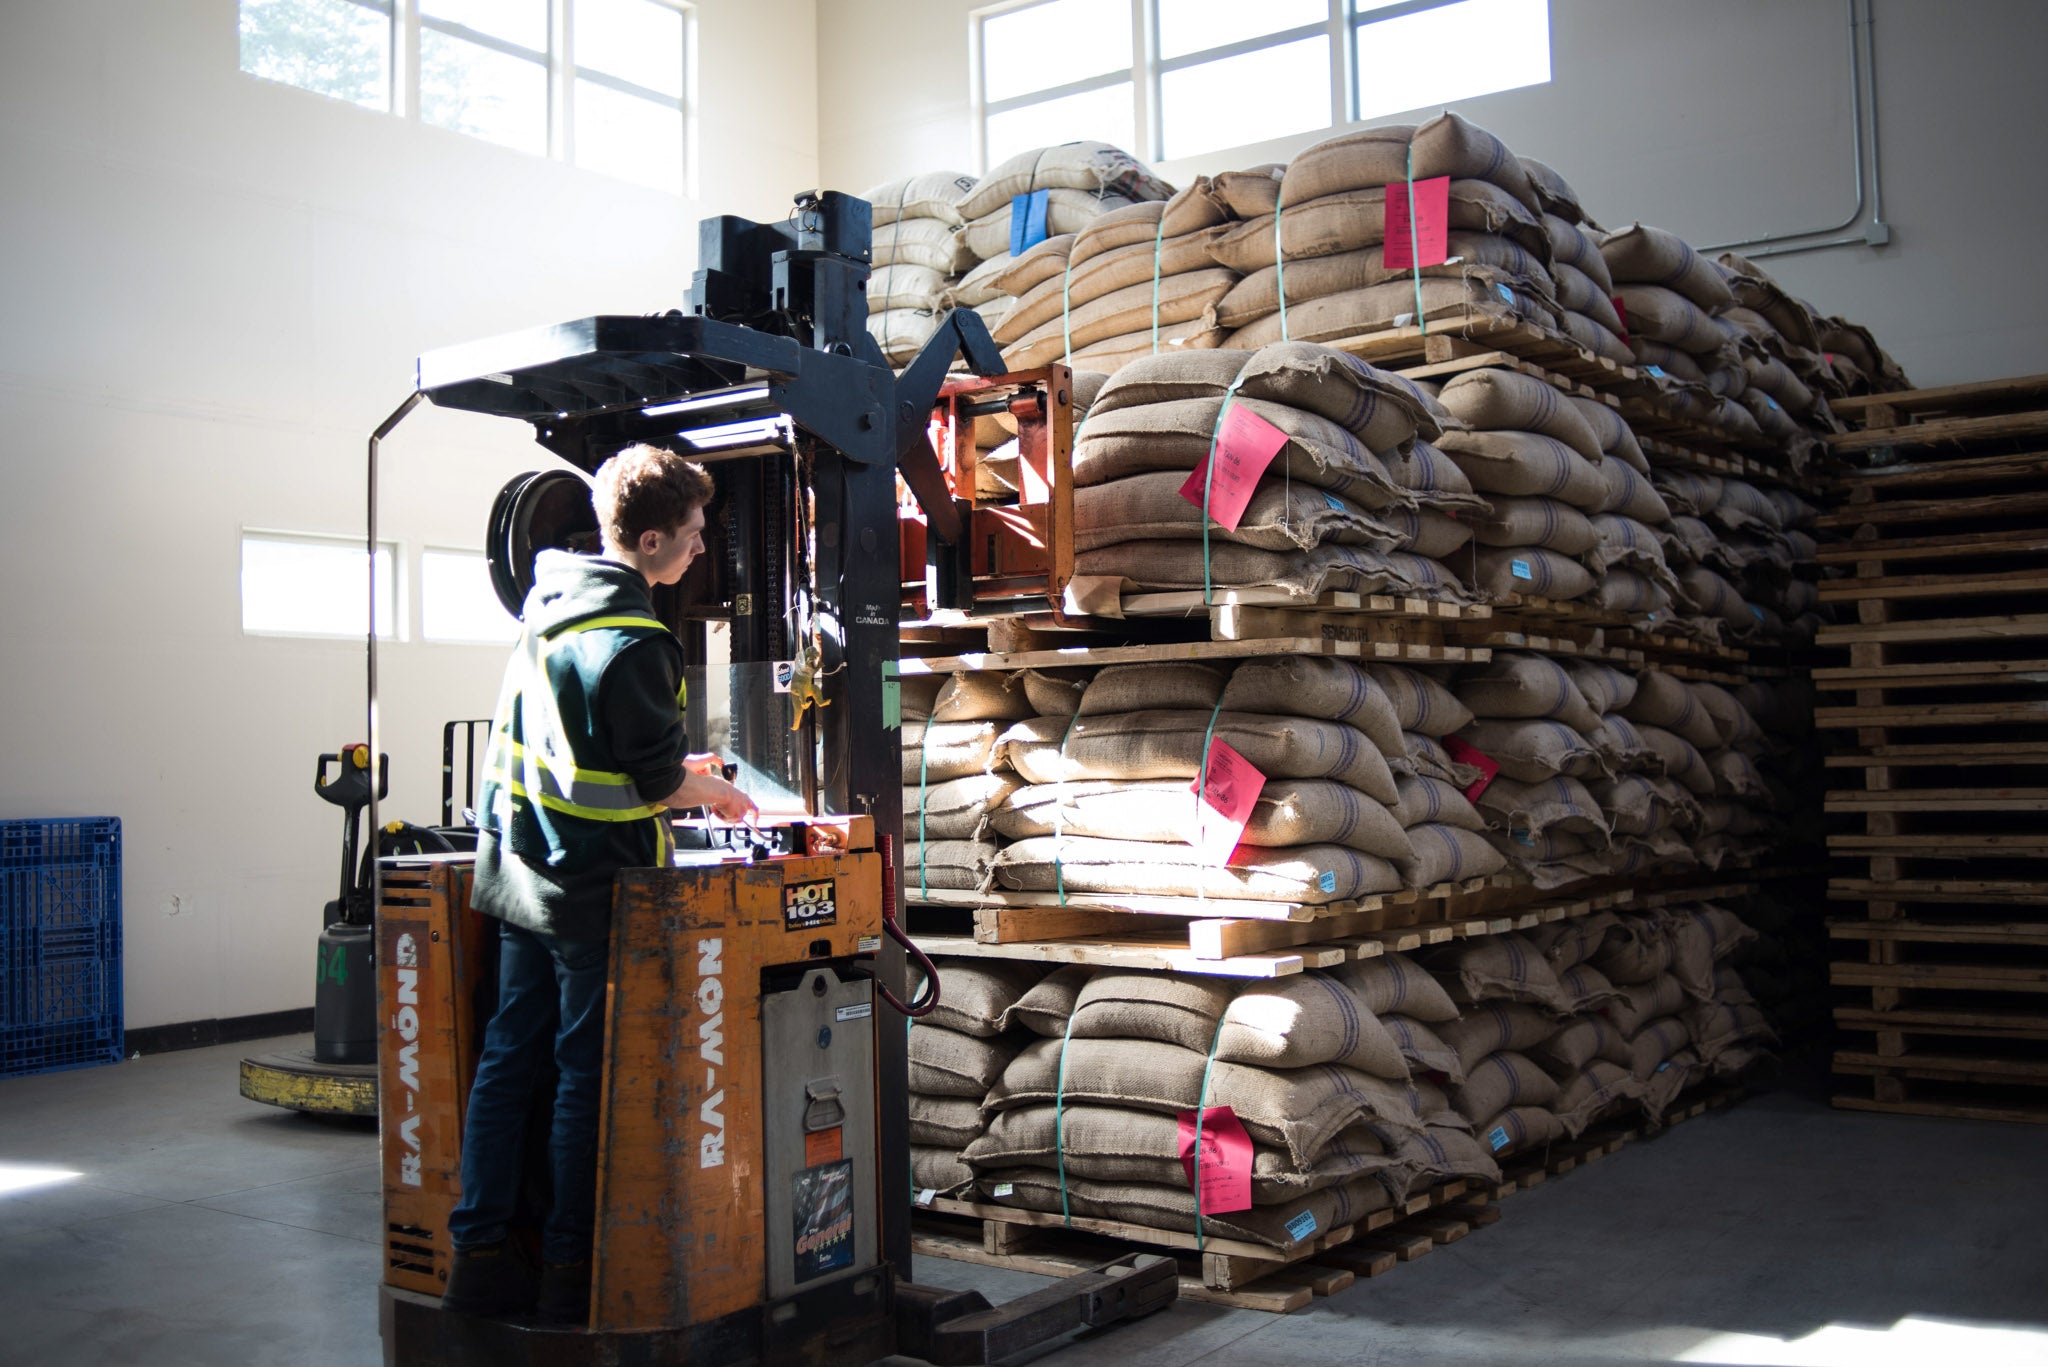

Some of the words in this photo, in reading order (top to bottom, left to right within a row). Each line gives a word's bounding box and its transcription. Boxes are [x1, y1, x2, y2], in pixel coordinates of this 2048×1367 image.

[855, 616, 889, 625] CANADA
[786, 882, 833, 906] HOT
[786, 901, 835, 919] 103
[796, 1212, 852, 1256] General
